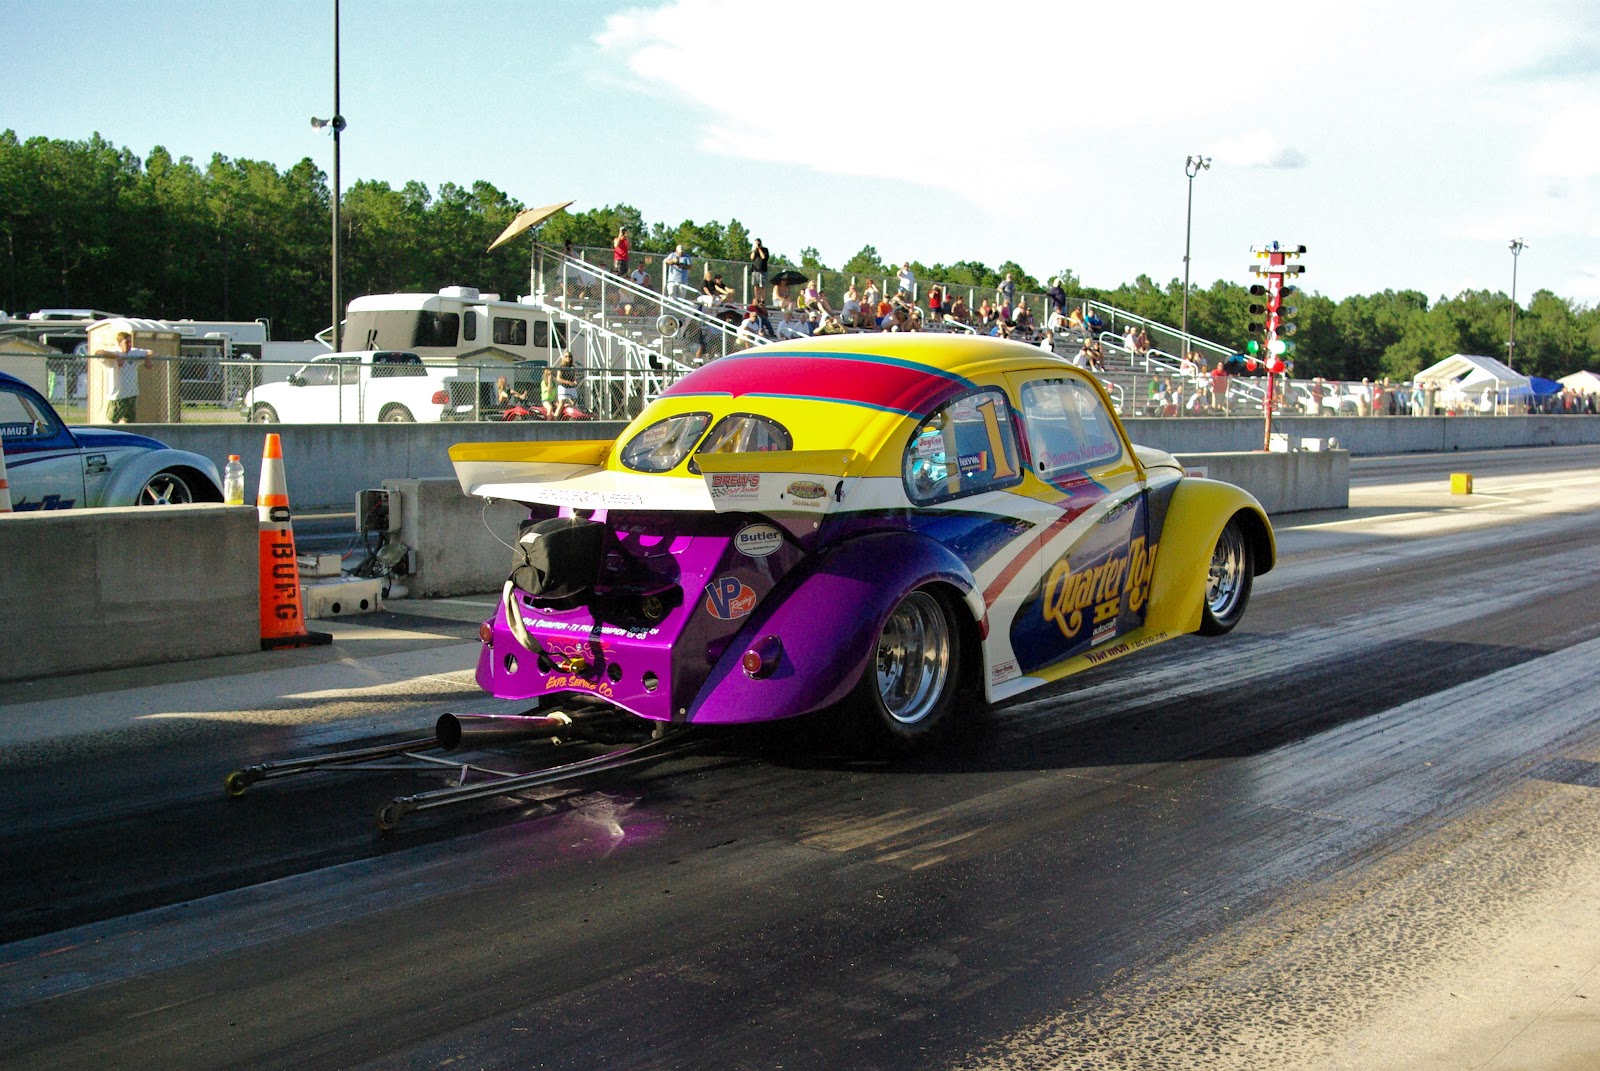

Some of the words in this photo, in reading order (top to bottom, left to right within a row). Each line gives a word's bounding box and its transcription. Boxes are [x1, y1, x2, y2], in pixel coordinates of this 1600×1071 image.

[976, 399, 1017, 480] 1
[712, 474, 760, 487] DREW'S
[740, 531, 779, 542] Butler
[705, 576, 741, 620] VP
[1043, 549, 1128, 638] Quarter
[1124, 535, 1159, 612] Toy
[569, 676, 597, 690] SERVICE
[599, 683, 613, 698] CO.
